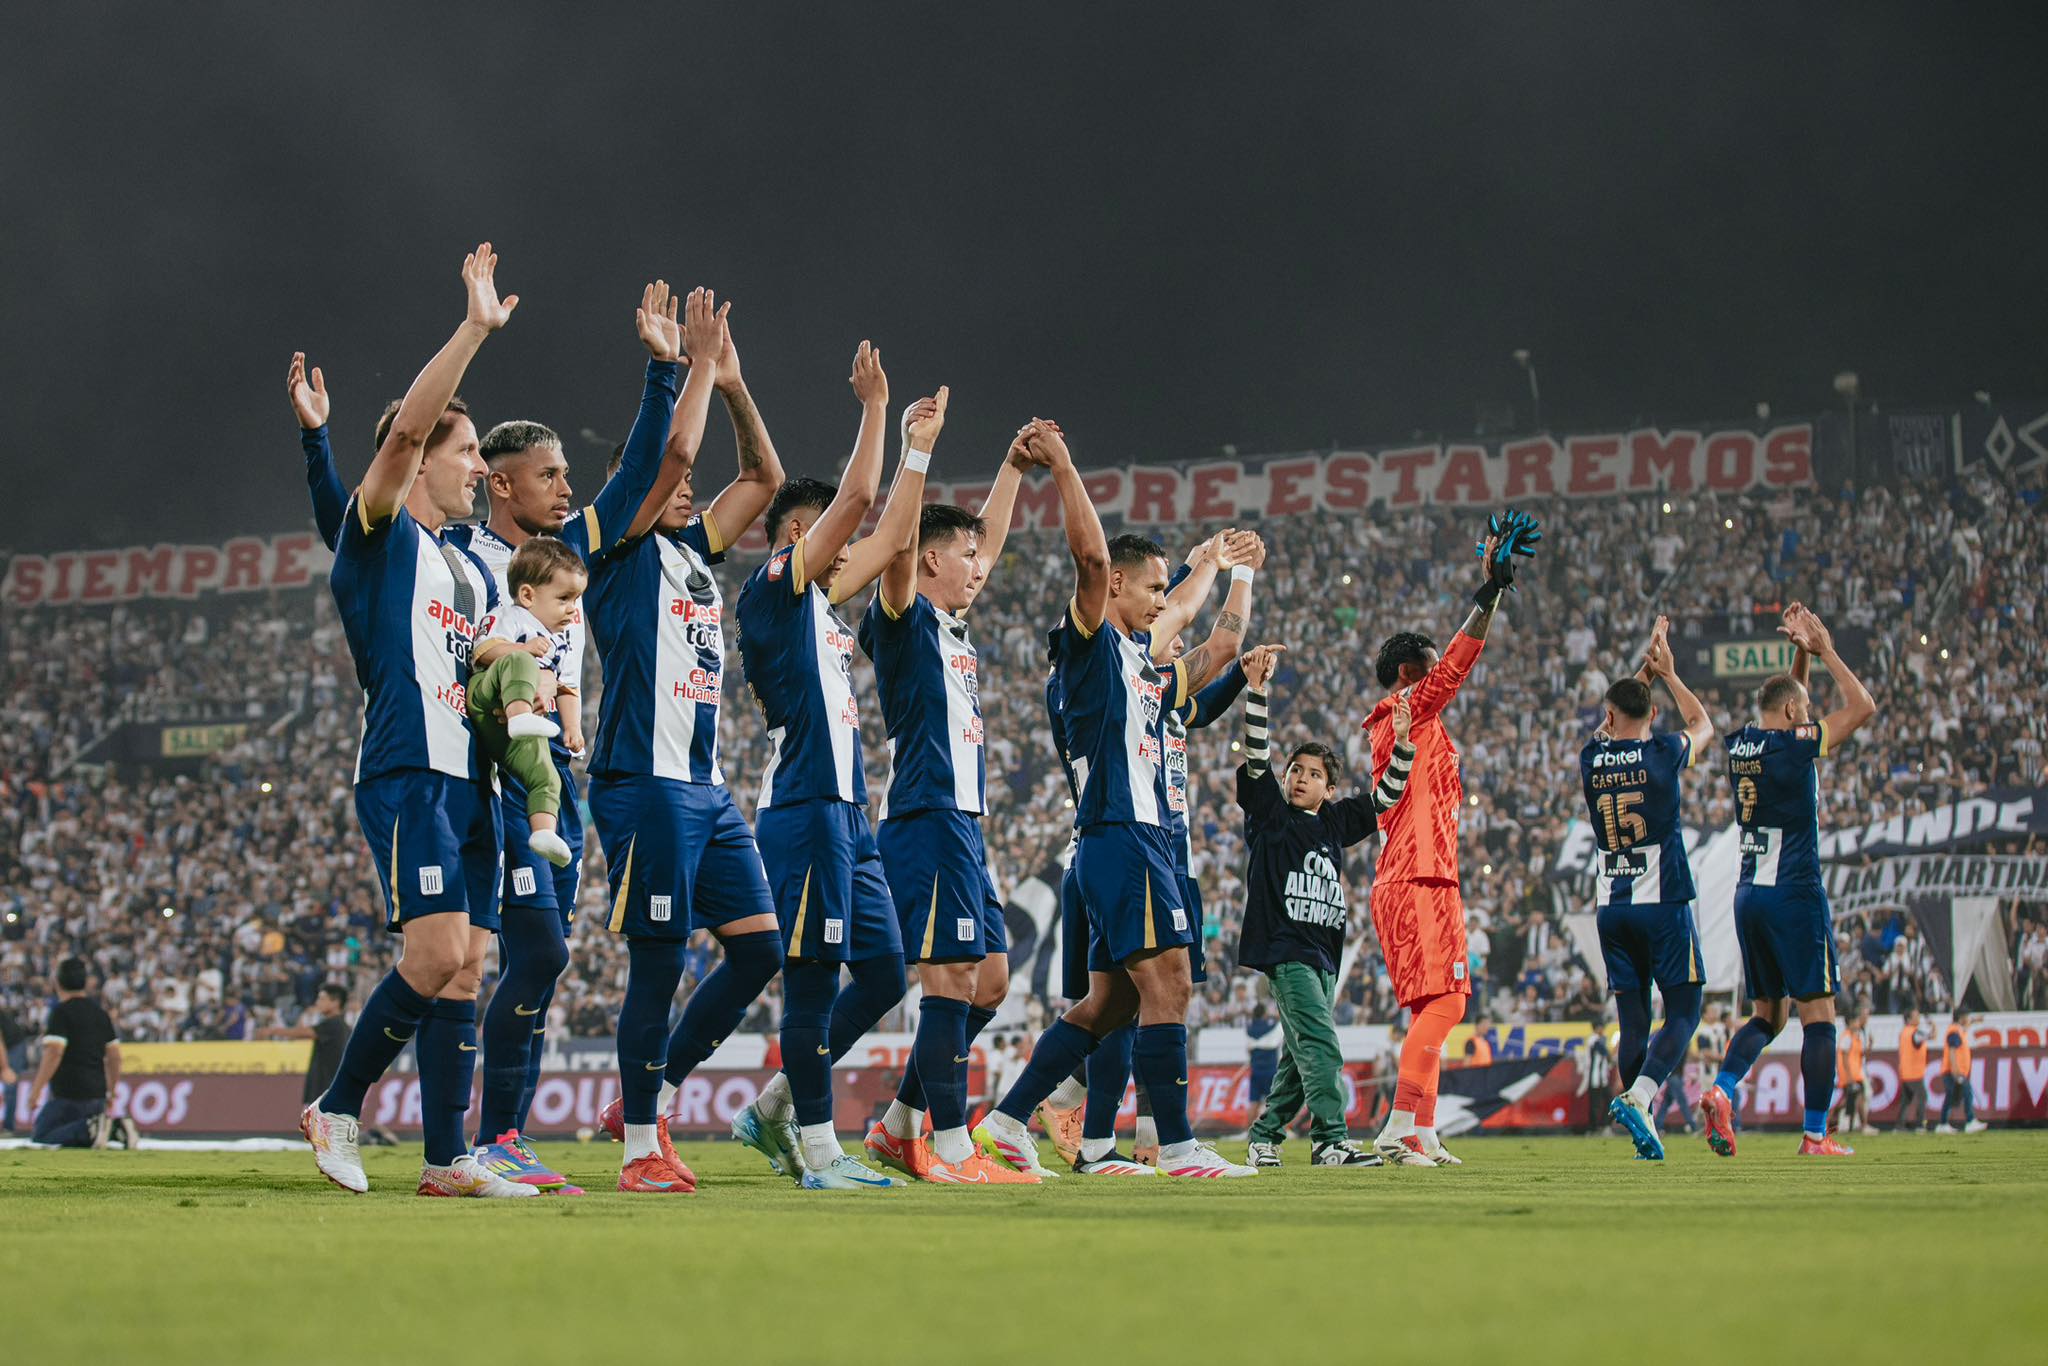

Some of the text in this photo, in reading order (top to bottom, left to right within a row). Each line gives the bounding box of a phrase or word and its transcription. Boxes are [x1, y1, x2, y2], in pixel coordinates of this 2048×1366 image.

[1266, 425, 1813, 517] ESTAREMOS
[10, 535, 315, 604] SIEMPRE
[1592, 769, 1648, 789] CASTILLO
[1597, 791, 1648, 852] 15
[1607, 867, 1646, 877] ANYPSA
